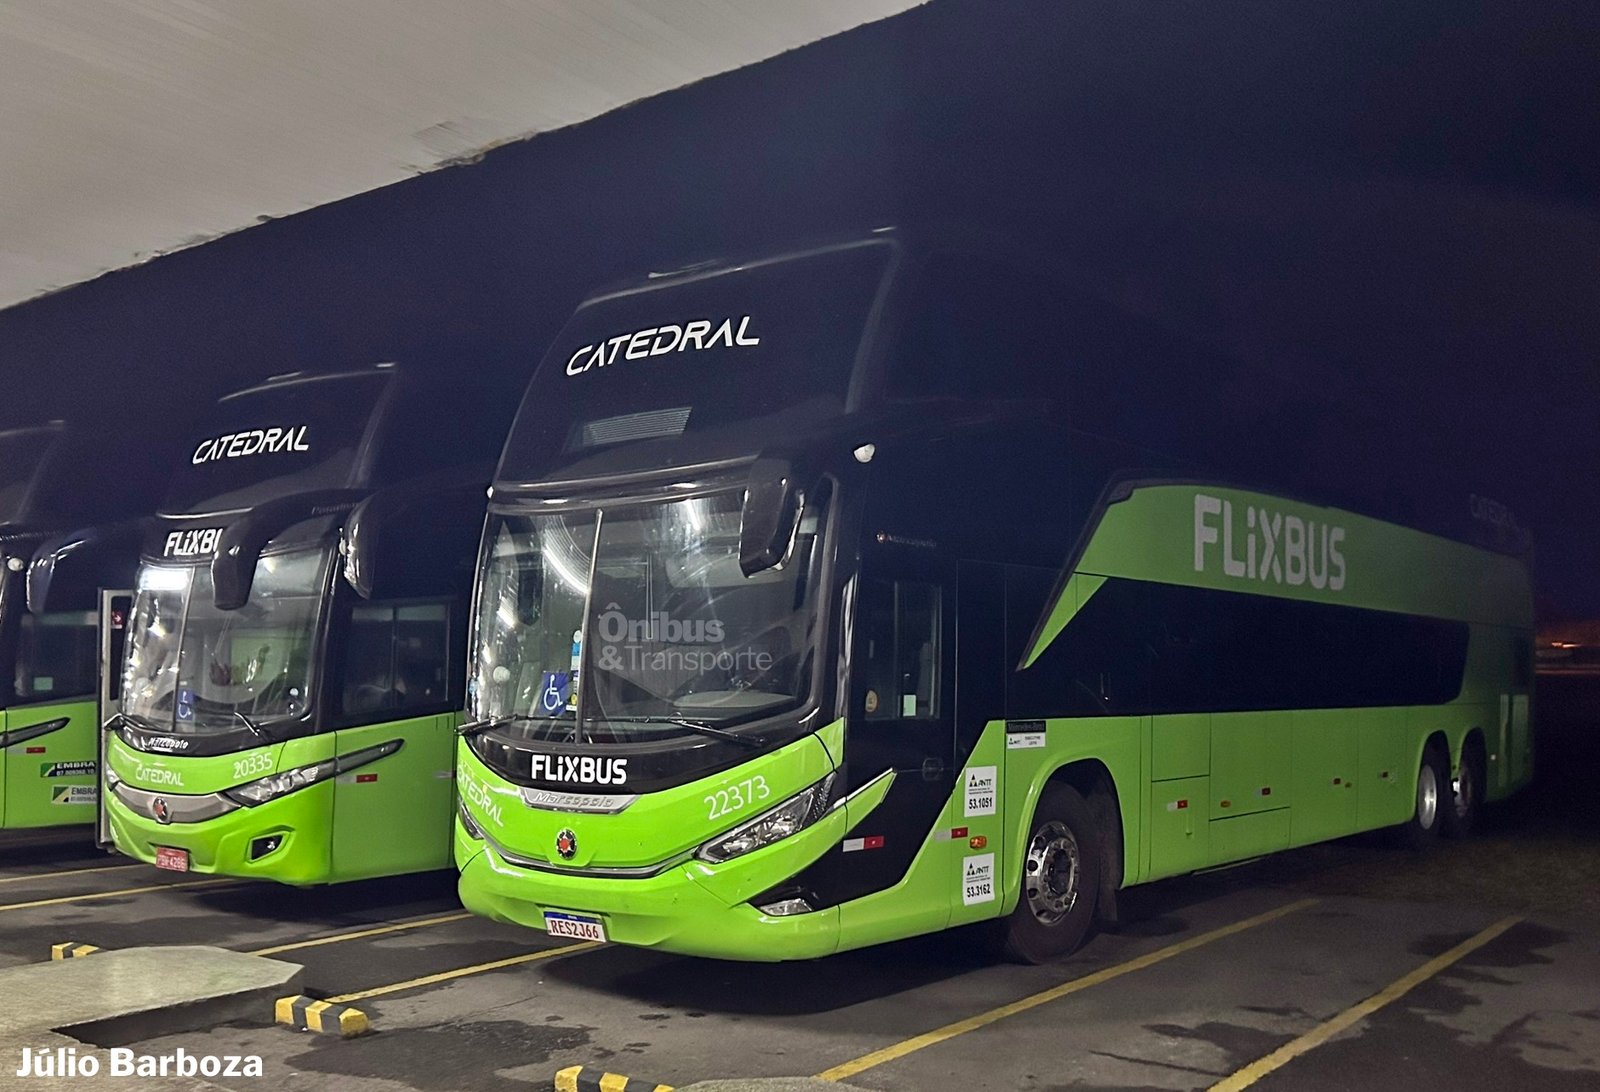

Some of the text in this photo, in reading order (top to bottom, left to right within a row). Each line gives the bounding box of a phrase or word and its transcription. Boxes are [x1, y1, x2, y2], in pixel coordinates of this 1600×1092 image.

[566, 316, 760, 377] CATEDRAL
[192, 426, 309, 465] CATEDRAL
[136, 764, 185, 787] CATEDRAL
[233, 753, 273, 779] 20335
[534, 792, 614, 808] Marcopolo
[703, 775, 771, 821] 22373
[968, 797, 993, 809] 53.1051
[966, 883, 991, 898] 53.3162
[550, 919, 599, 939] RES2J66
